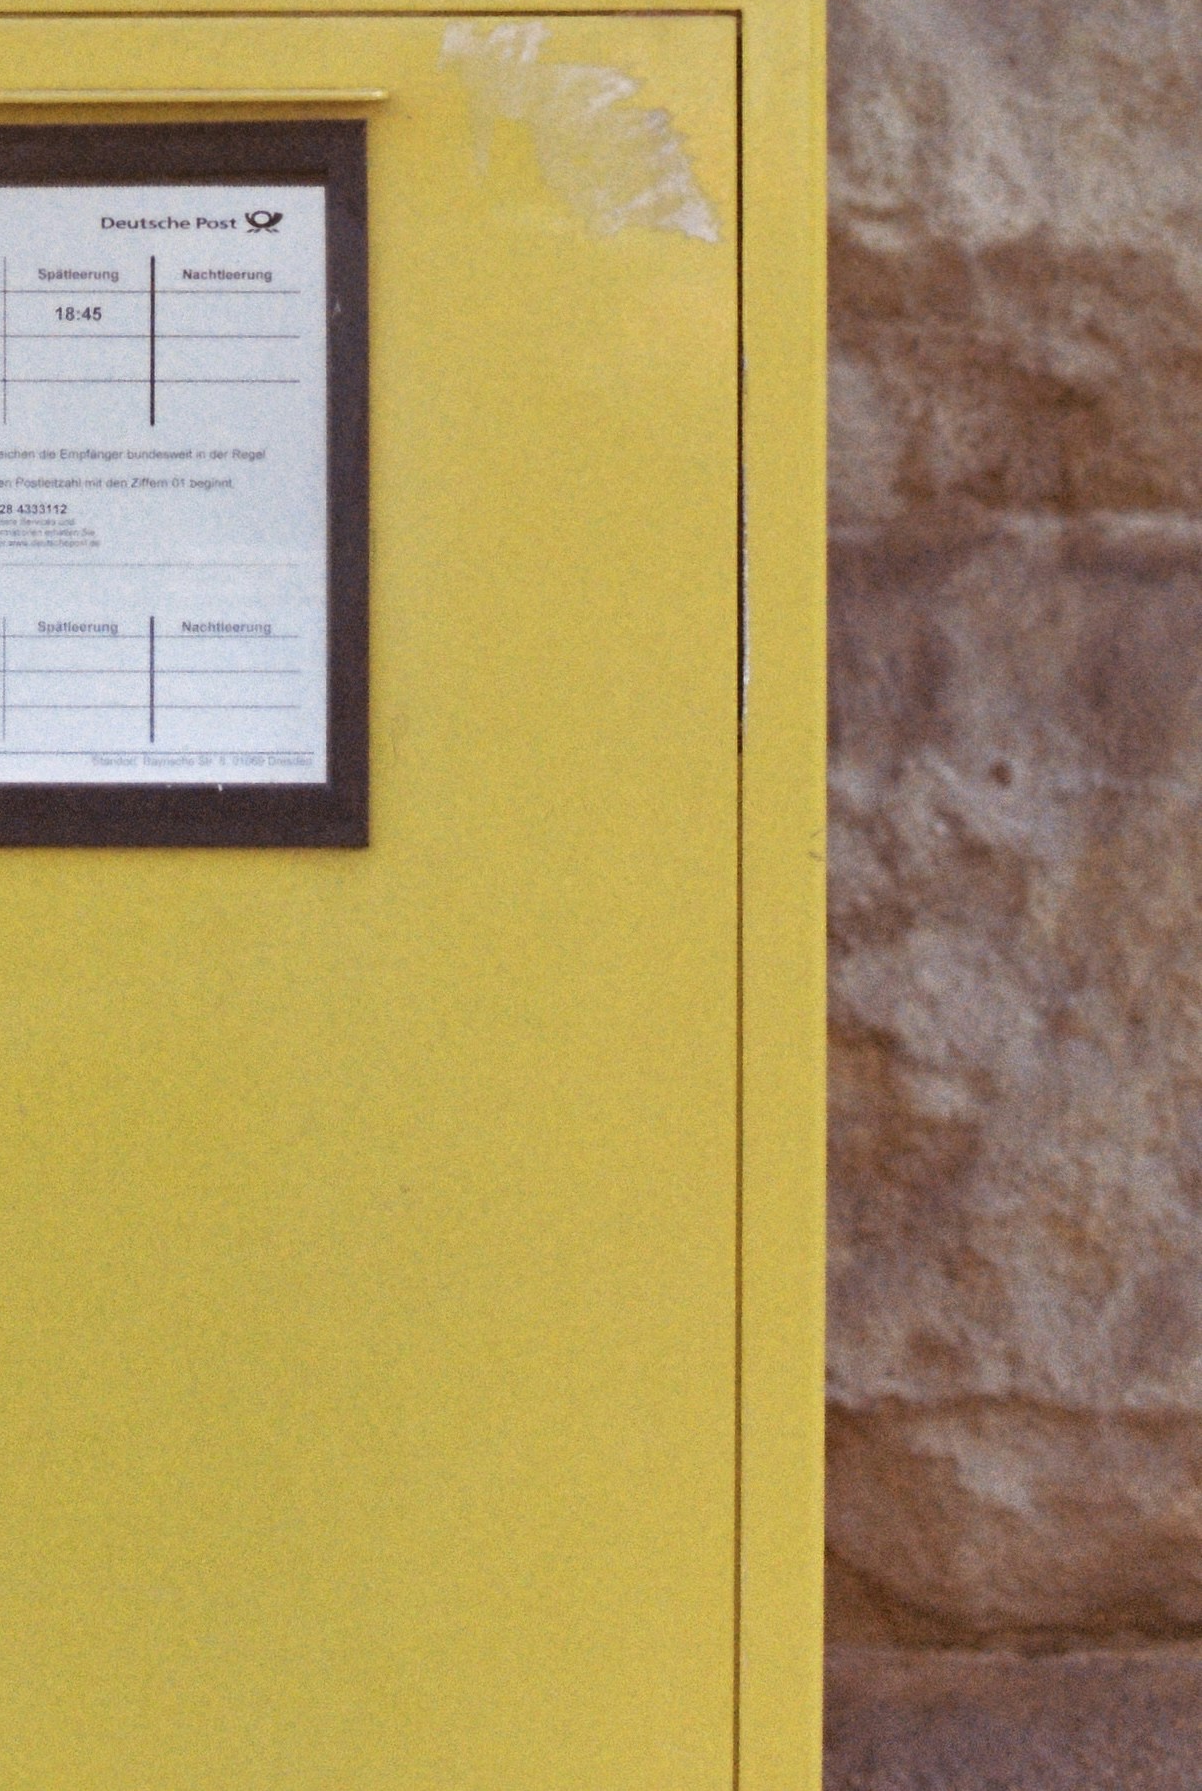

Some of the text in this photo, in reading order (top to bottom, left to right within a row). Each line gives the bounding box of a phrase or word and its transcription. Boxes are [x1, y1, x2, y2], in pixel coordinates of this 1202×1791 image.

[101, 217, 237, 231] Deutsche Post
[38, 266, 119, 283] Spätleerung
[182, 268, 272, 283] Nachtleerung
[56, 306, 102, 322] 18:45
[39, 449, 56, 460] die
[127, 449, 192, 460] bundesweit
[210, 449, 228, 459] der
[232, 449, 266, 461] Regel
[16, 477, 81, 488] Postleitzahl
[85, 478, 102, 488] mit
[106, 478, 127, 488] den
[17, 504, 67, 515] 4333112
[38, 621, 118, 635] Spätleerung
[181, 621, 271, 635] Nachtleerung
